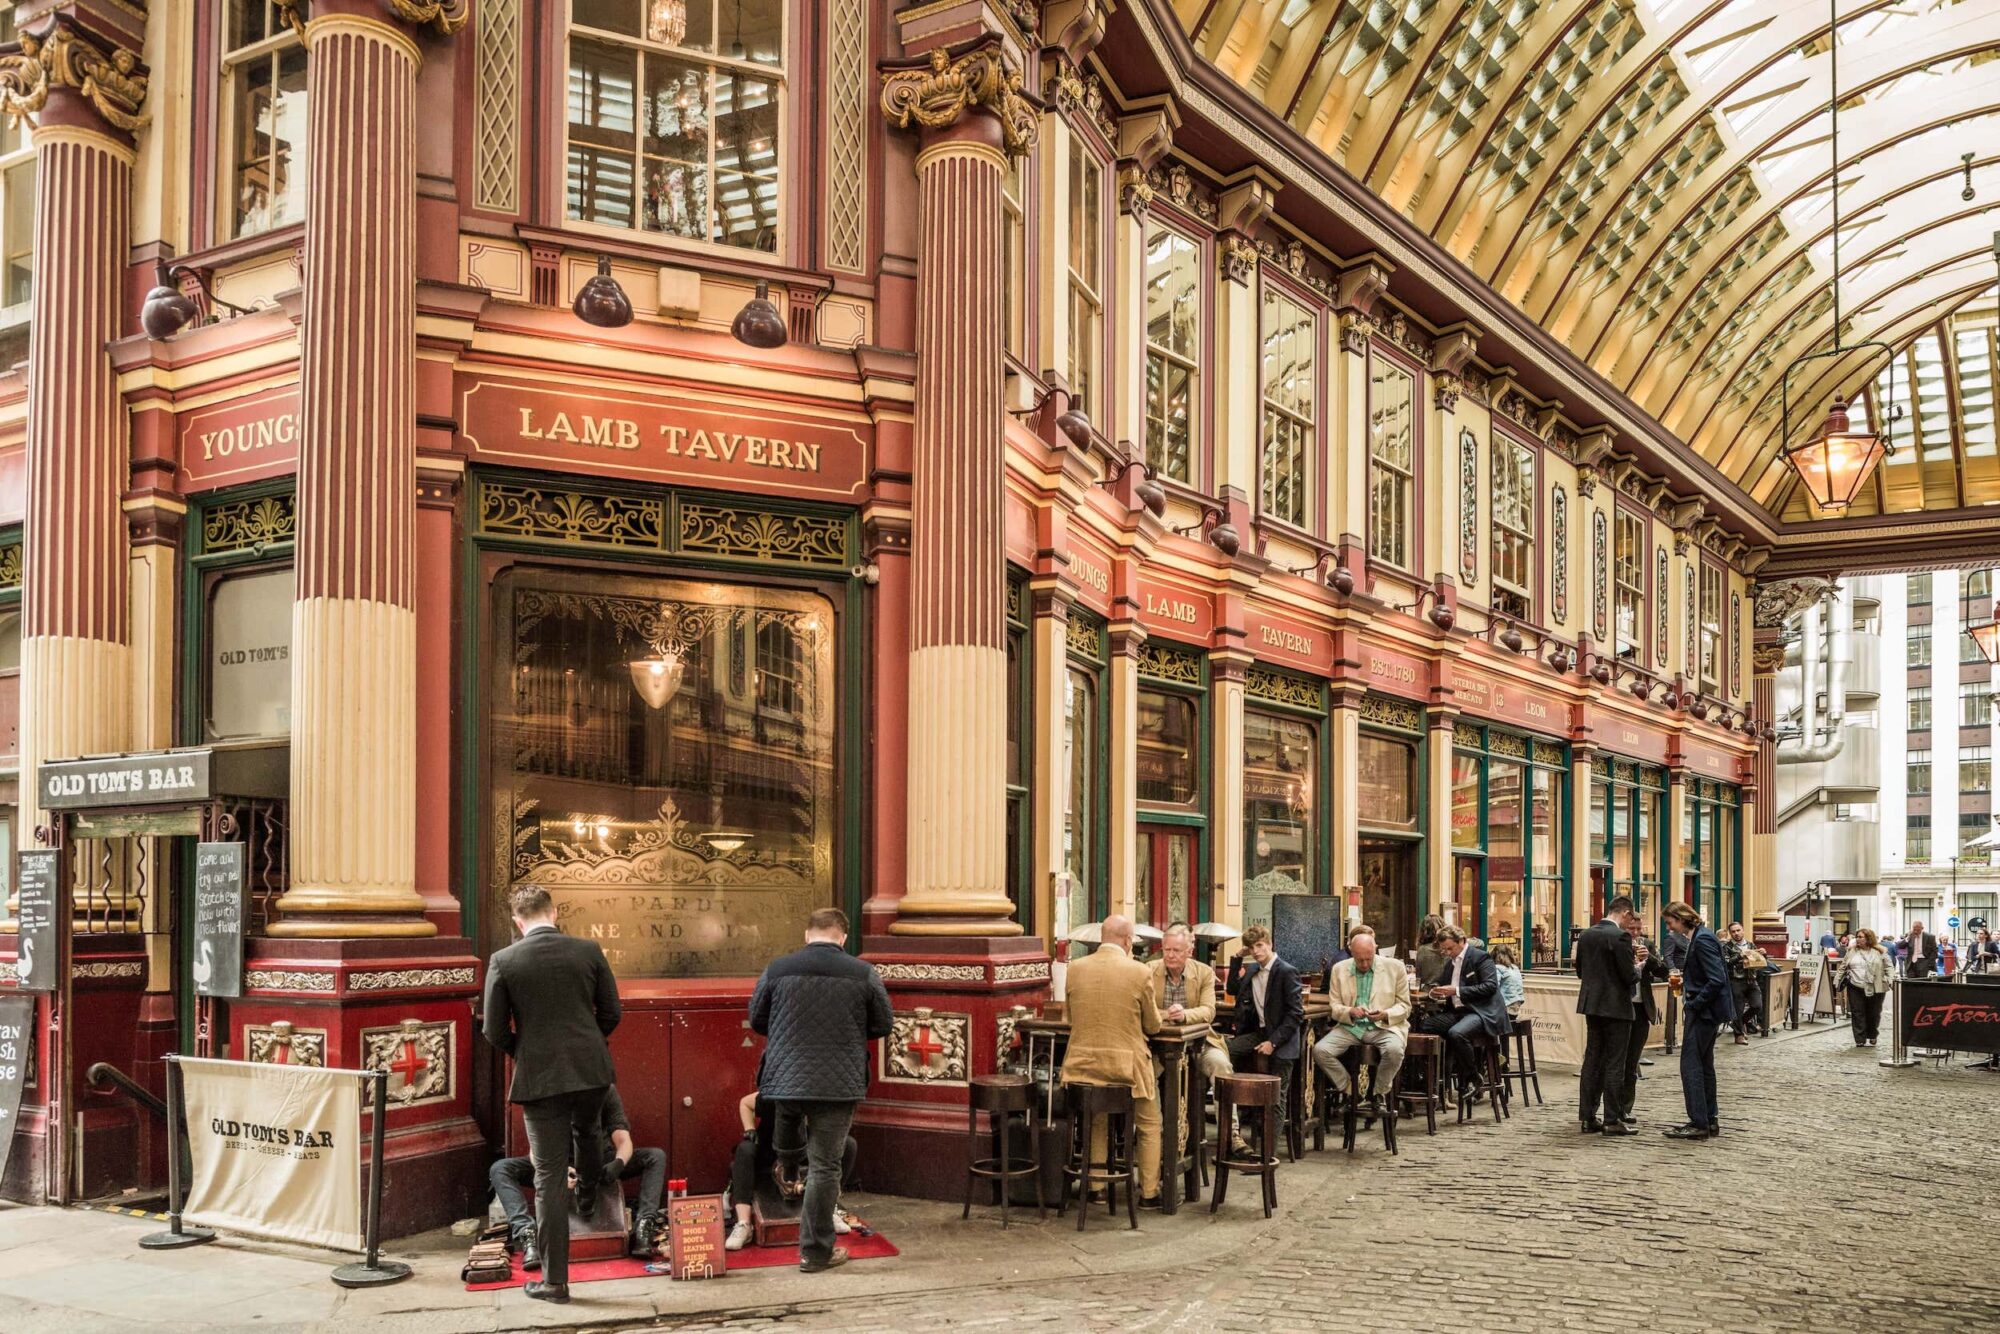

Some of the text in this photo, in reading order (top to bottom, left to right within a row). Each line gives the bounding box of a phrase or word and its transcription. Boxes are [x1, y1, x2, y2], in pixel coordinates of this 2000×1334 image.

[200, 413, 300, 461] YOUNG
[519, 407, 820, 472] LAMB TAVERN
[1067, 551, 1108, 594] OUNGS
[1146, 593, 1197, 624] LAMB
[1260, 625, 1313, 656] TAVERN
[220, 646, 289, 666] OLD TOM'S
[1525, 701, 1546, 718] LEON
[1622, 730, 1640, 746] LEON
[48, 766, 195, 798] OLD TOM'S BAR
[220, 850, 234, 865] and
[199, 872, 211, 891] try
[1520, 1008, 1535, 1016] THE
[1912, 1003, 2000, 1027] La Tasca
[1531, 1015, 1562, 1030] Tavern
[1533, 1034, 1567, 1043] UPSTAIRS
[212, 1118, 335, 1149] OLD TOM'S BAR
[682, 1227, 707, 1236] SHOES
[682, 1236, 705, 1245] BOOTS
[683, 1243, 715, 1253] LEATHER
[684, 1253, 708, 1263] SUEDE
